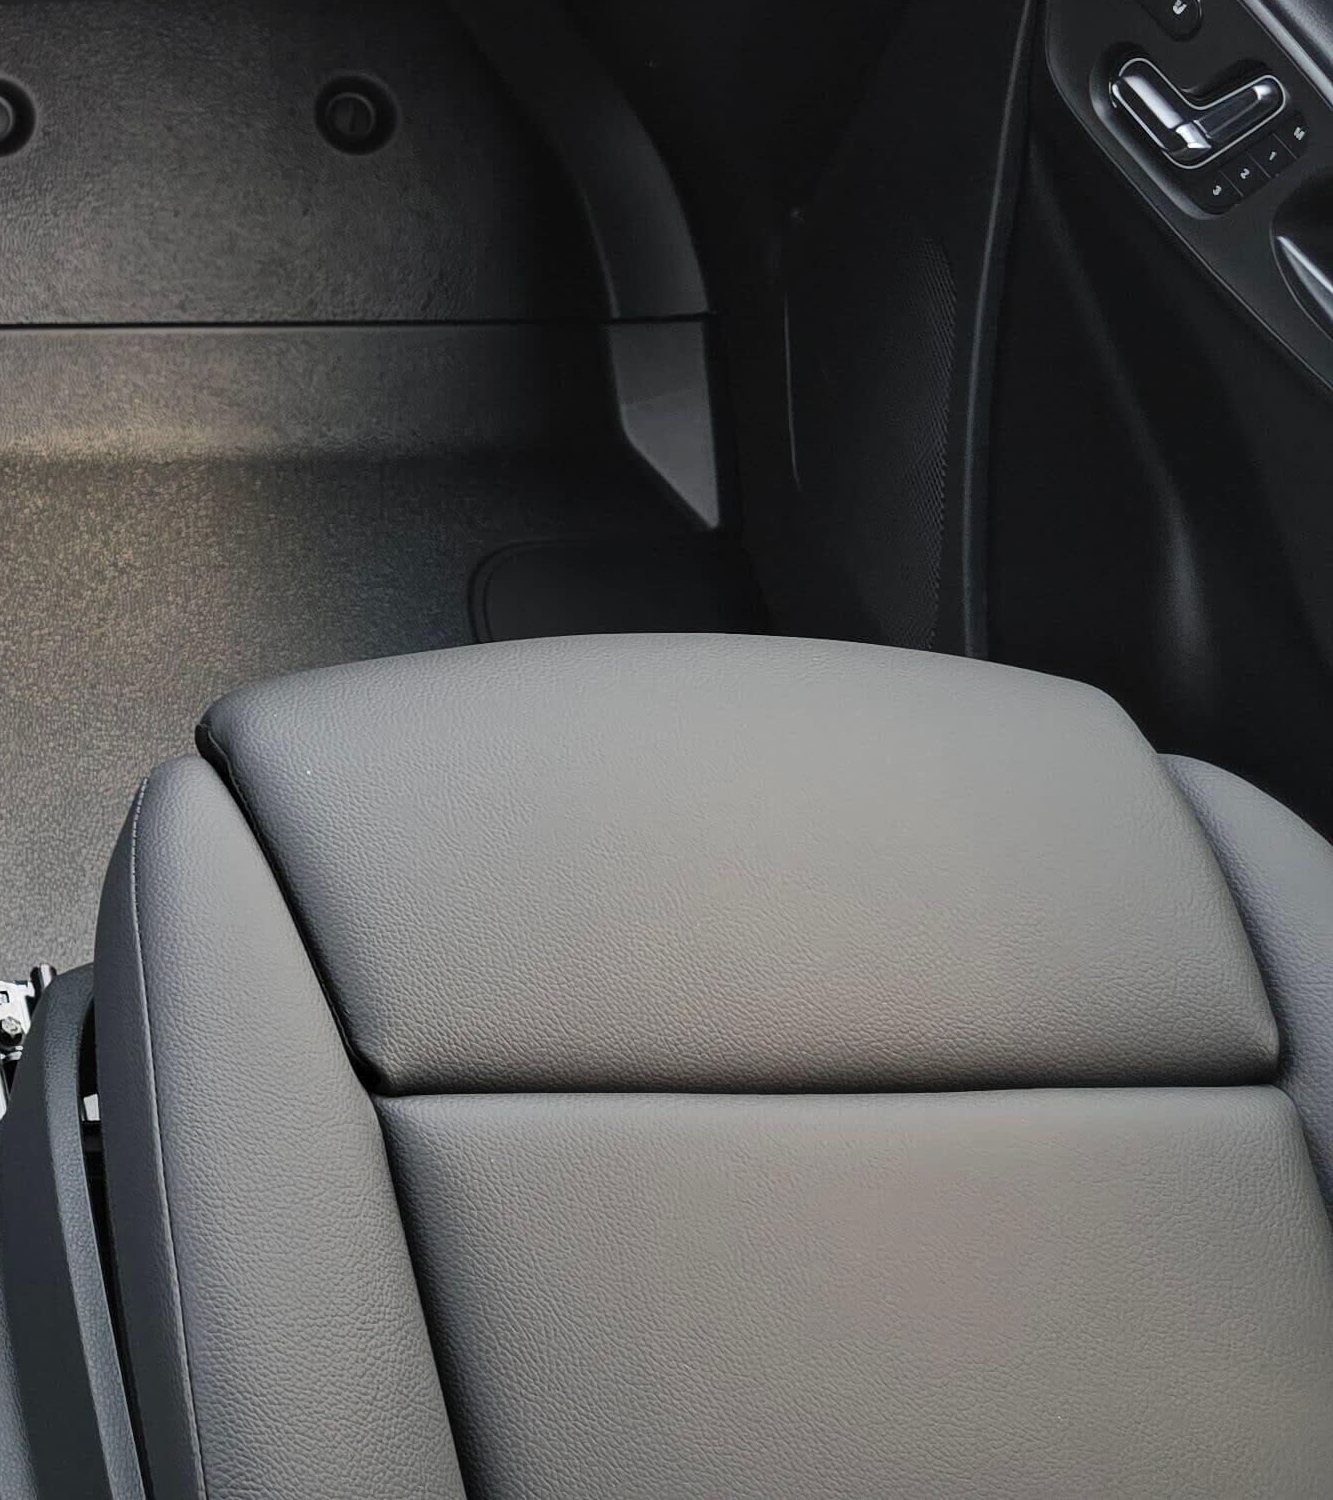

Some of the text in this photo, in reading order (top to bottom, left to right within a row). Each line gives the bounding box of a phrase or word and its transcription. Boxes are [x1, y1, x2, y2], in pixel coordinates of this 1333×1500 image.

[1269, 152, 1276, 160] 1
[1241, 168, 1250, 179] 2
[1213, 185, 1222, 195] 3
